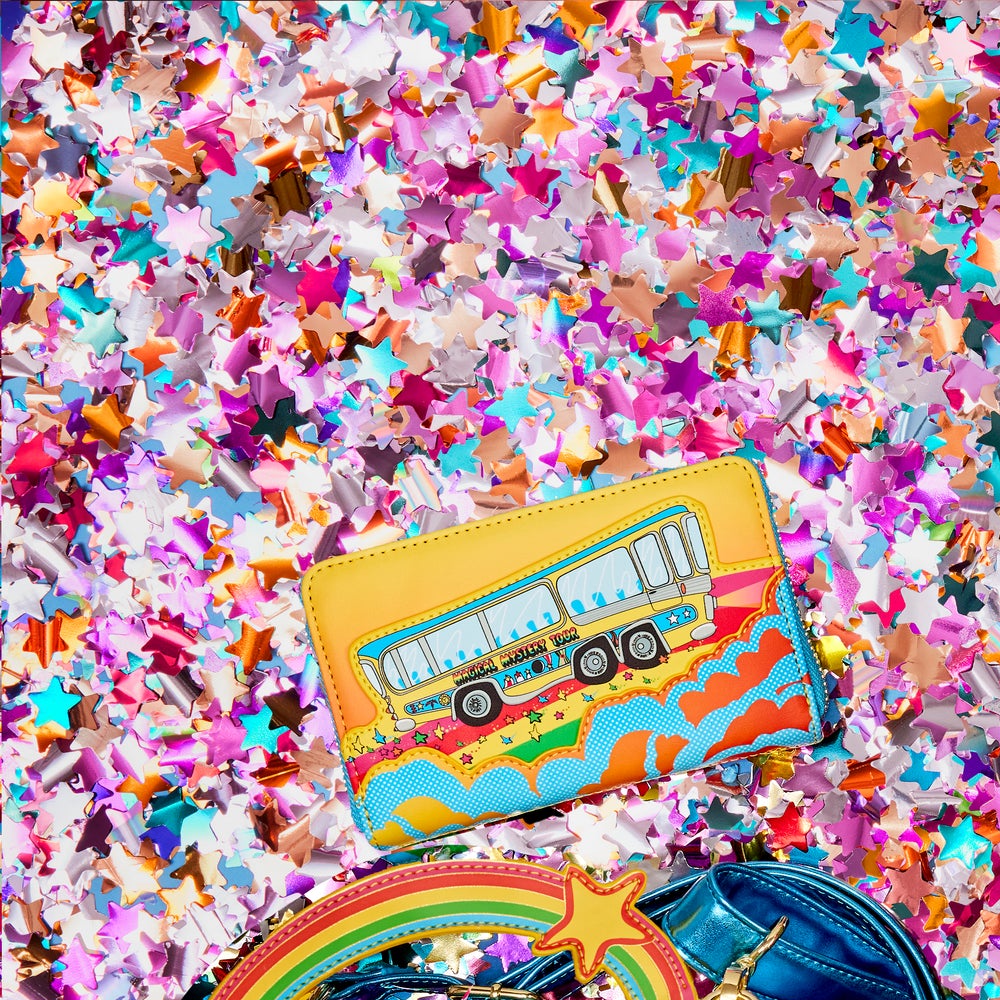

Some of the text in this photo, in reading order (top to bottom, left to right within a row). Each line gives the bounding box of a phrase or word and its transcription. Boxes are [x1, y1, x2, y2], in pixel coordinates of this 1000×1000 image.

[451, 626, 580, 687] MAGICAL MYSTERY TOUR
